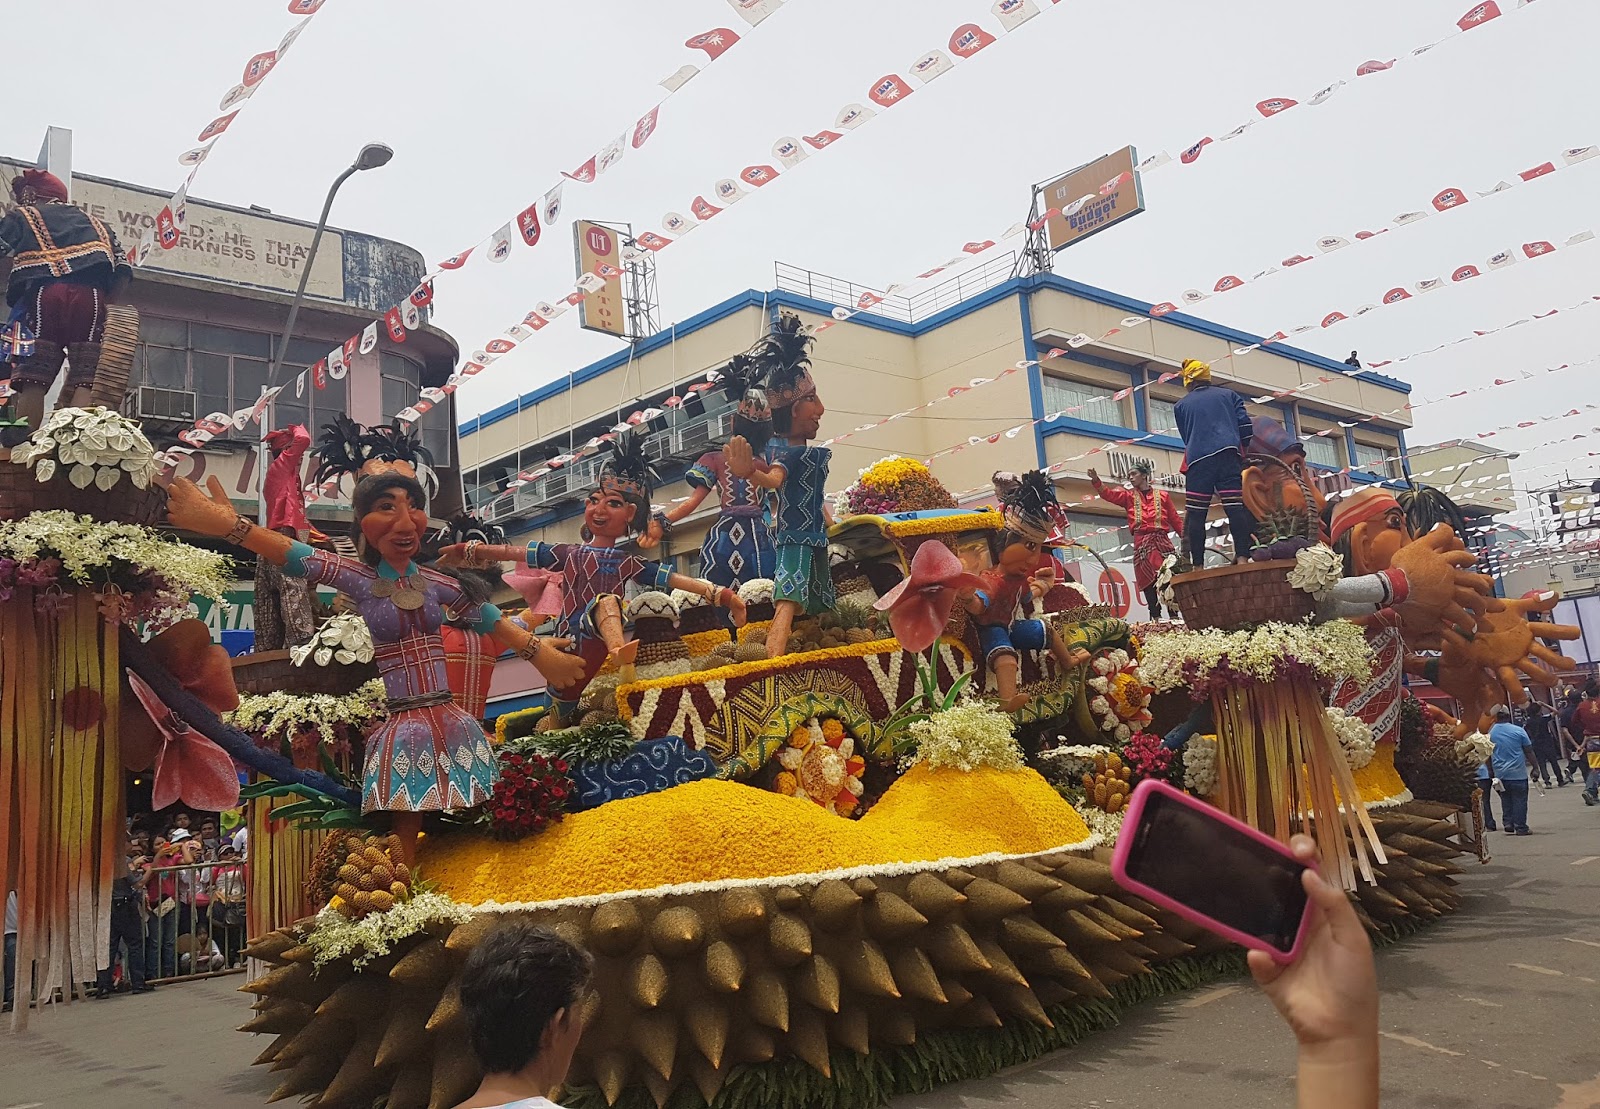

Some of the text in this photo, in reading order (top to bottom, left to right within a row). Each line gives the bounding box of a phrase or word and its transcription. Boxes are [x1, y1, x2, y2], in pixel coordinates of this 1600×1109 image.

[1070, 199, 1117, 230] Budget
[123, 226, 142, 239] IN
[154, 231, 256, 261] DRKNESS
[266, 252, 299, 269] BUT
[224, 231, 252, 248] HE
